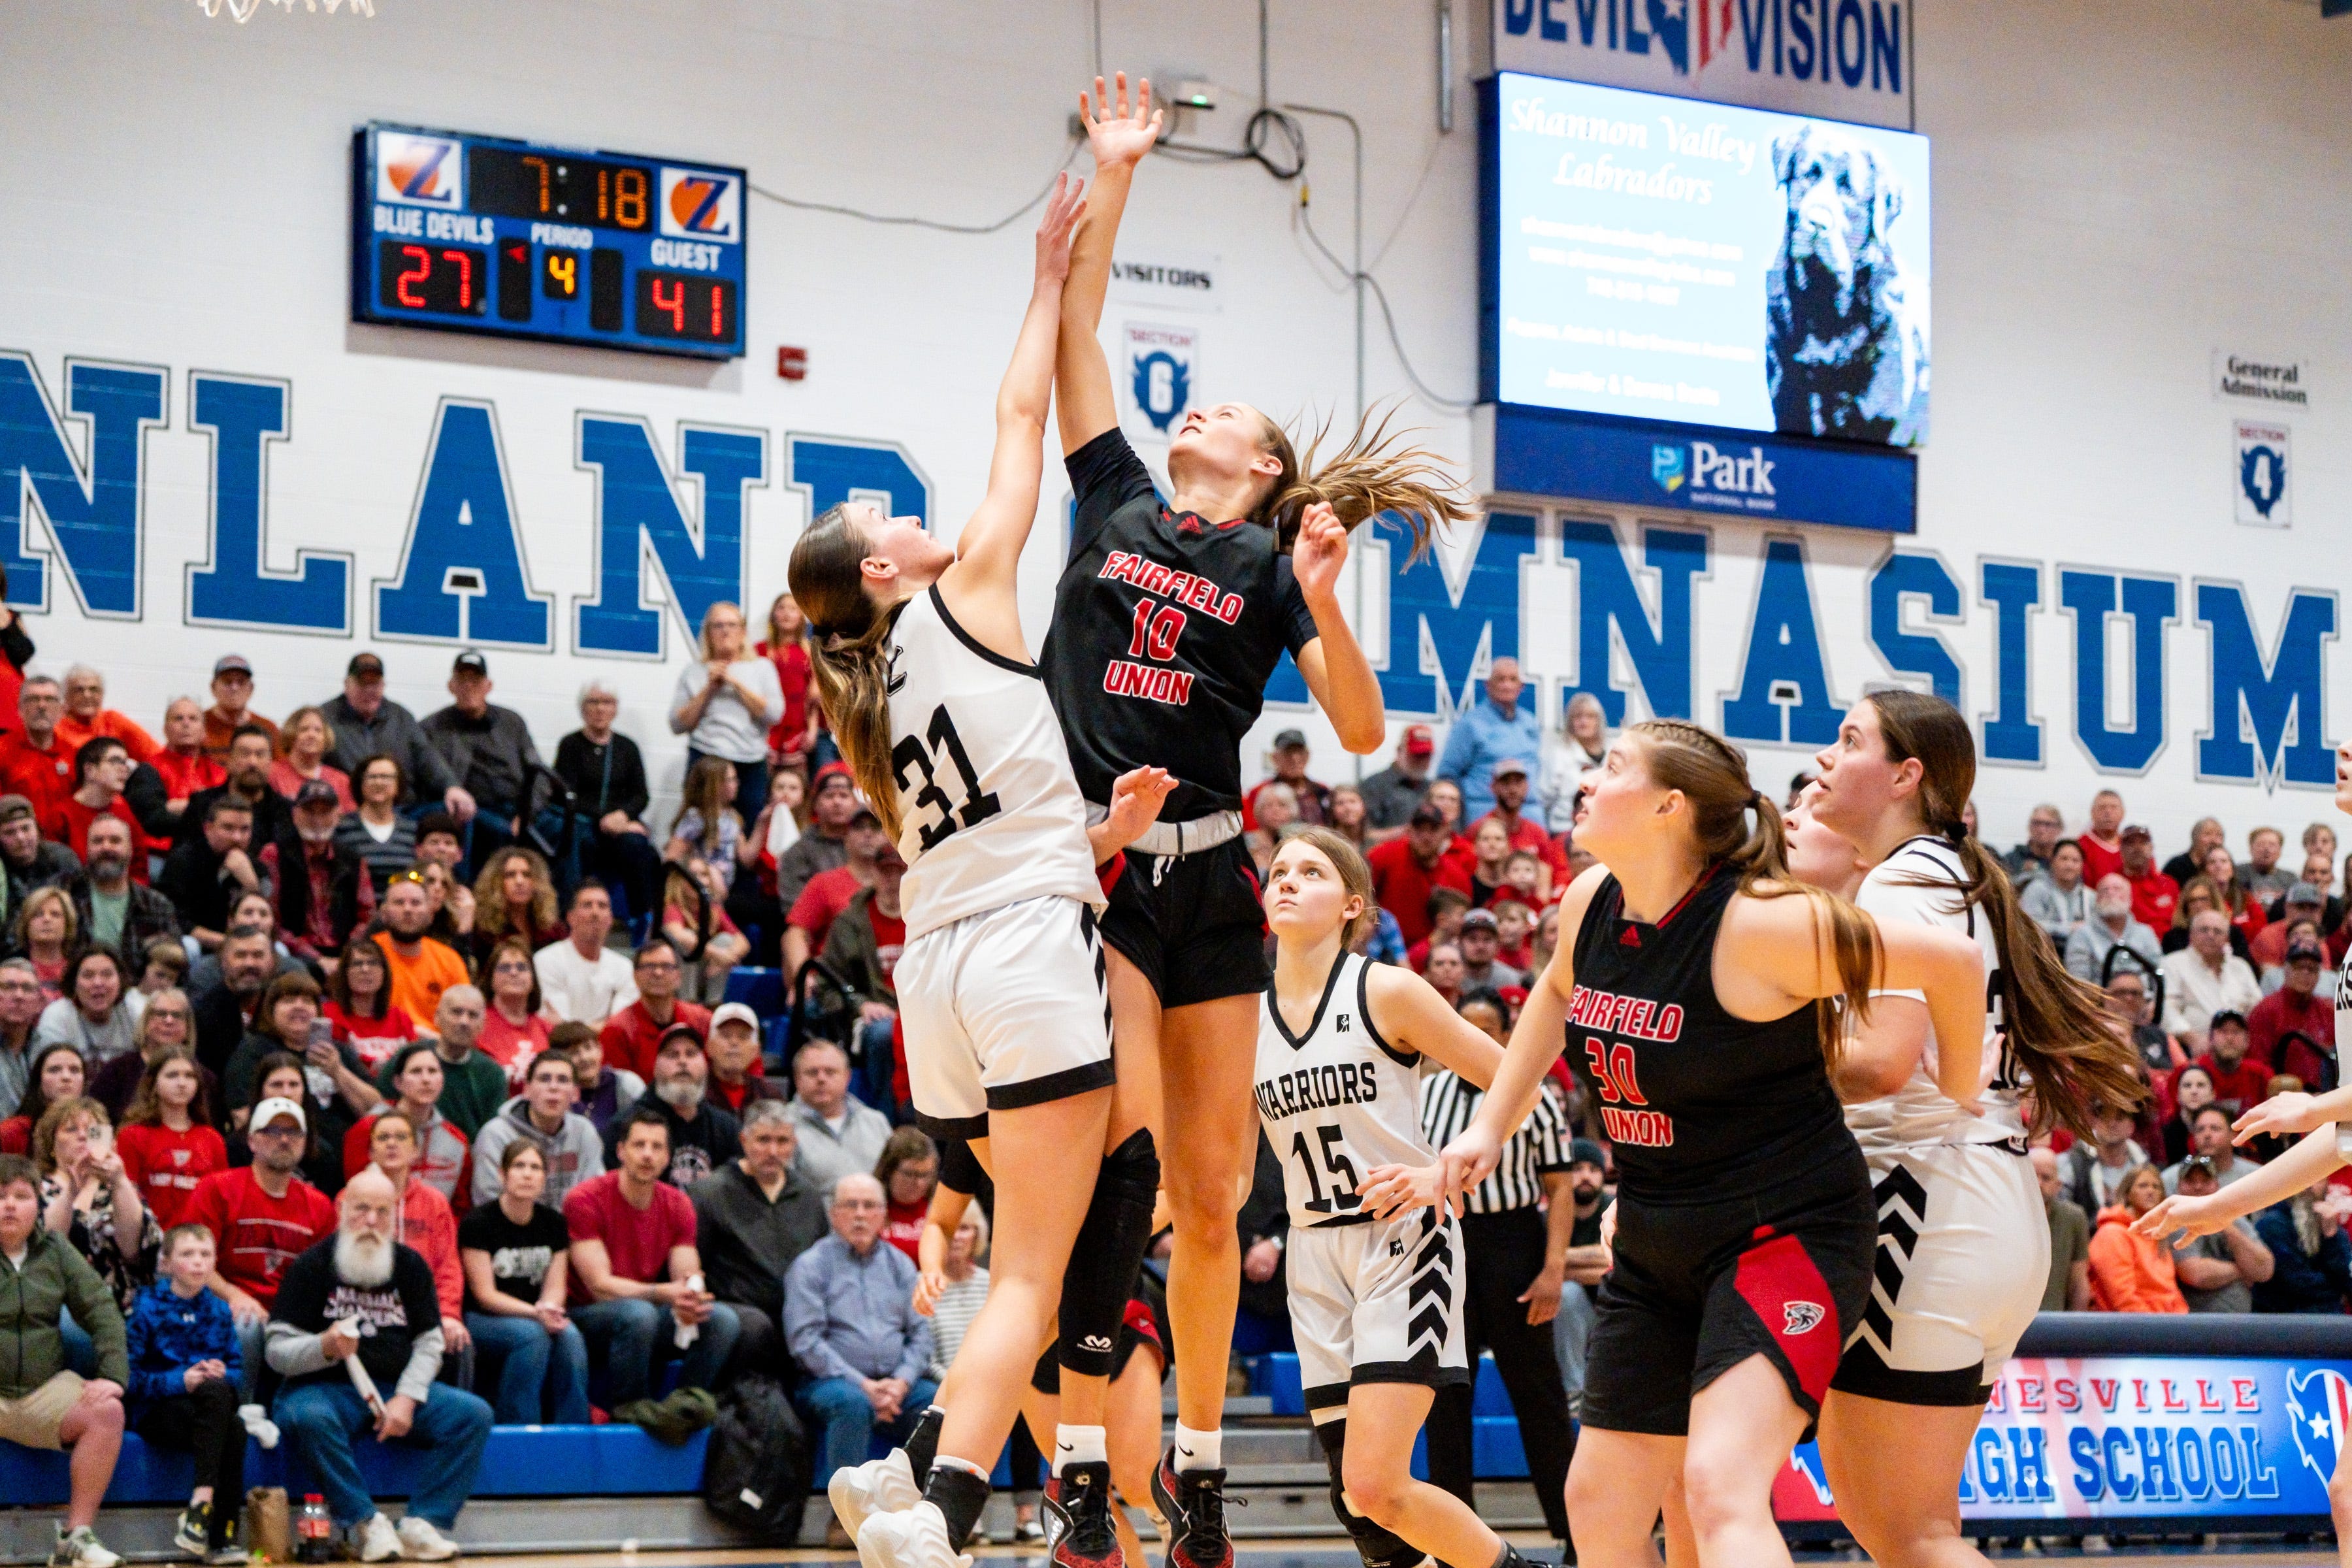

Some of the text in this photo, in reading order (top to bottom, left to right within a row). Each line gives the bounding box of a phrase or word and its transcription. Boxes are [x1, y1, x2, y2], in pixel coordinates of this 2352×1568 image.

[1739, 0, 1901, 93] VISION
[1509, 97, 1756, 176] Shannon Valley
[523, 157, 647, 229] 7:18
[1552, 152, 1714, 205] Labradors
[374, 206, 494, 244] BLUE DEVILS
[531, 223, 593, 249] PERIOD
[397, 246, 471, 308] 27
[549, 256, 574, 295] 4
[651, 238, 721, 270] GUEST
[1111, 264, 1212, 290] VISITORS
[653, 279, 721, 336] 41
[1130, 329, 1192, 347] SECTION
[1149, 361, 1174, 414] 6
[2221, 376, 2307, 404] Admission
[2227, 355, 2298, 382] General
[1690, 441, 1776, 495] Park
[1098, 550, 1244, 625] FAIRFIELD
[1128, 597, 1186, 662] 10
[1261, 504, 2340, 792] MNASIUM
[1103, 659, 1194, 706] UNION
[892, 703, 1001, 851] 31
[1254, 1062, 1377, 1122] WARRIORS
[1586, 1036, 1648, 1105] 30
[1601, 1106, 1674, 1147] UNION
[1292, 1124, 1363, 1213] 15
[2068, 1424, 2280, 1500] SCHOOL
